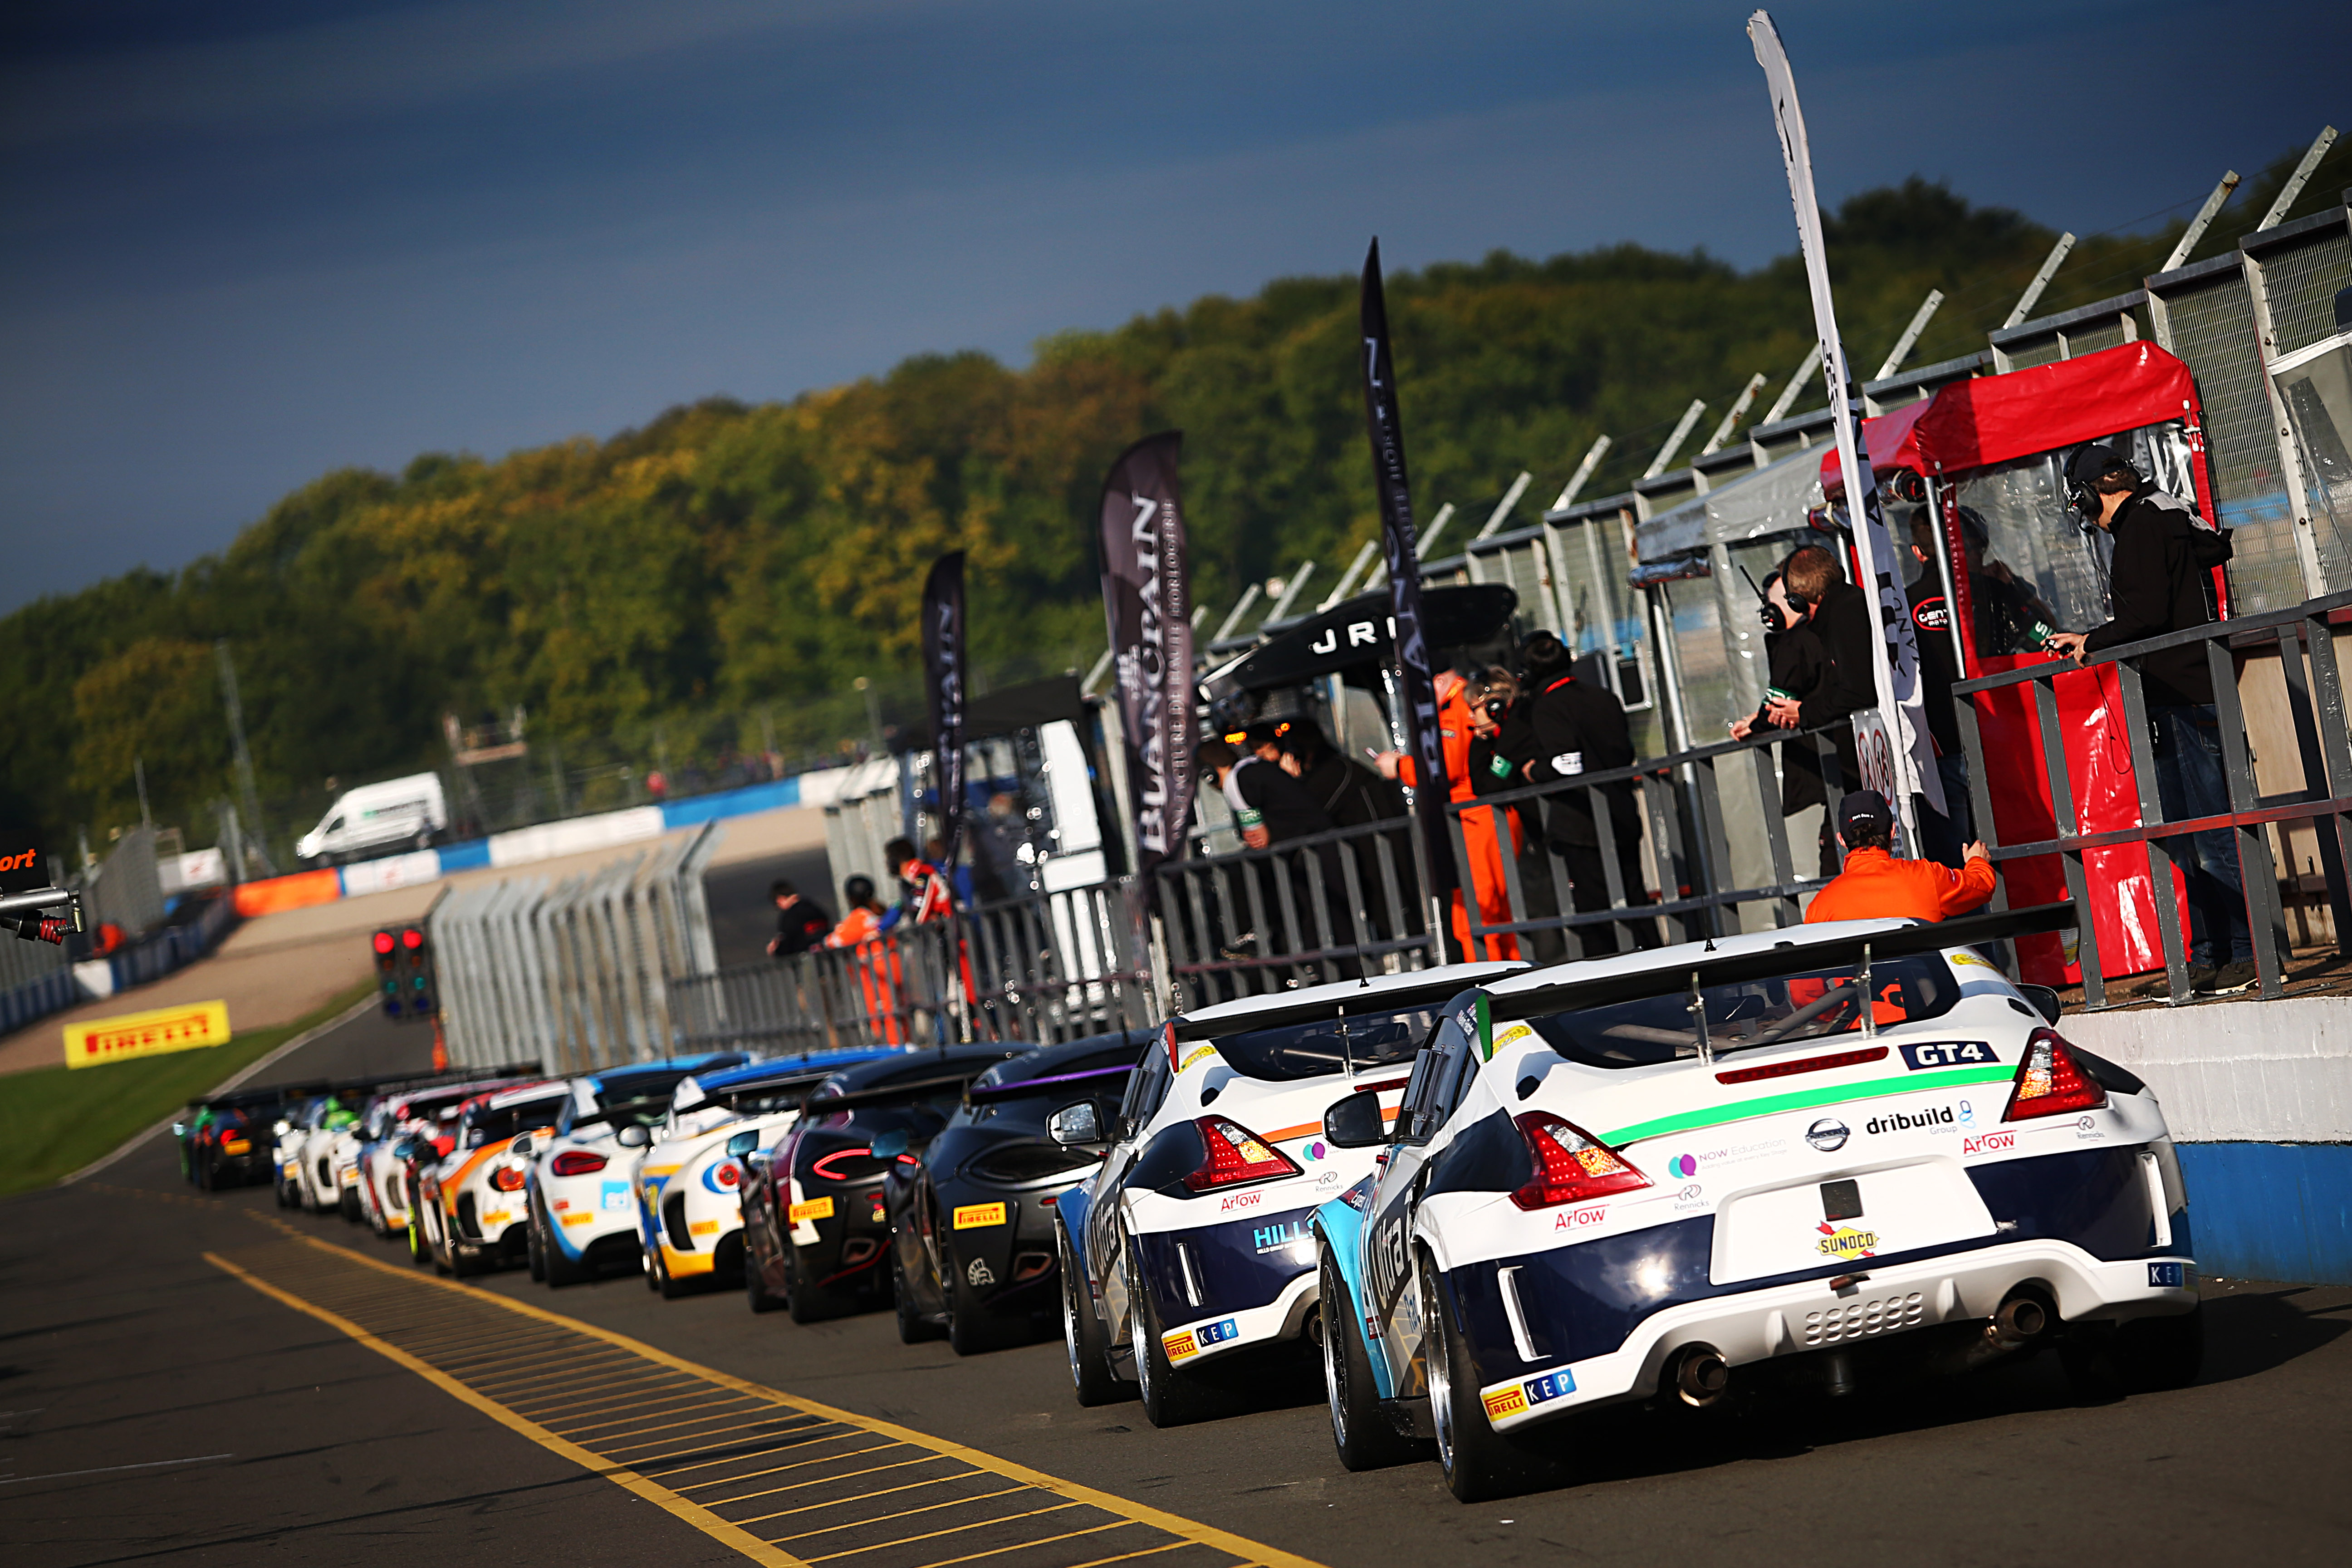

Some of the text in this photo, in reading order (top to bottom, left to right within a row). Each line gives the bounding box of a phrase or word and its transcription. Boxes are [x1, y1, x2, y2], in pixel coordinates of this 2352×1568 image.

[1313, 616, 1397, 654] JRI
[1168, 718, 1190, 841] ANUFACTURE
[1916, 1044, 1984, 1065] GT4
[1867, 1107, 1954, 1134] dribuild
[1930, 1125, 1958, 1135] Group
[1699, 1138, 1786, 1162] NOW Education
[1674, 1199, 1710, 1211] Rennicks
[1820, 1231, 1875, 1253] SUNOCO
[1164, 1335, 1195, 1357] PIRELLI
[1485, 1390, 1524, 1416] PIRELLI
[1558, 1395, 1576, 1404] GROUP
